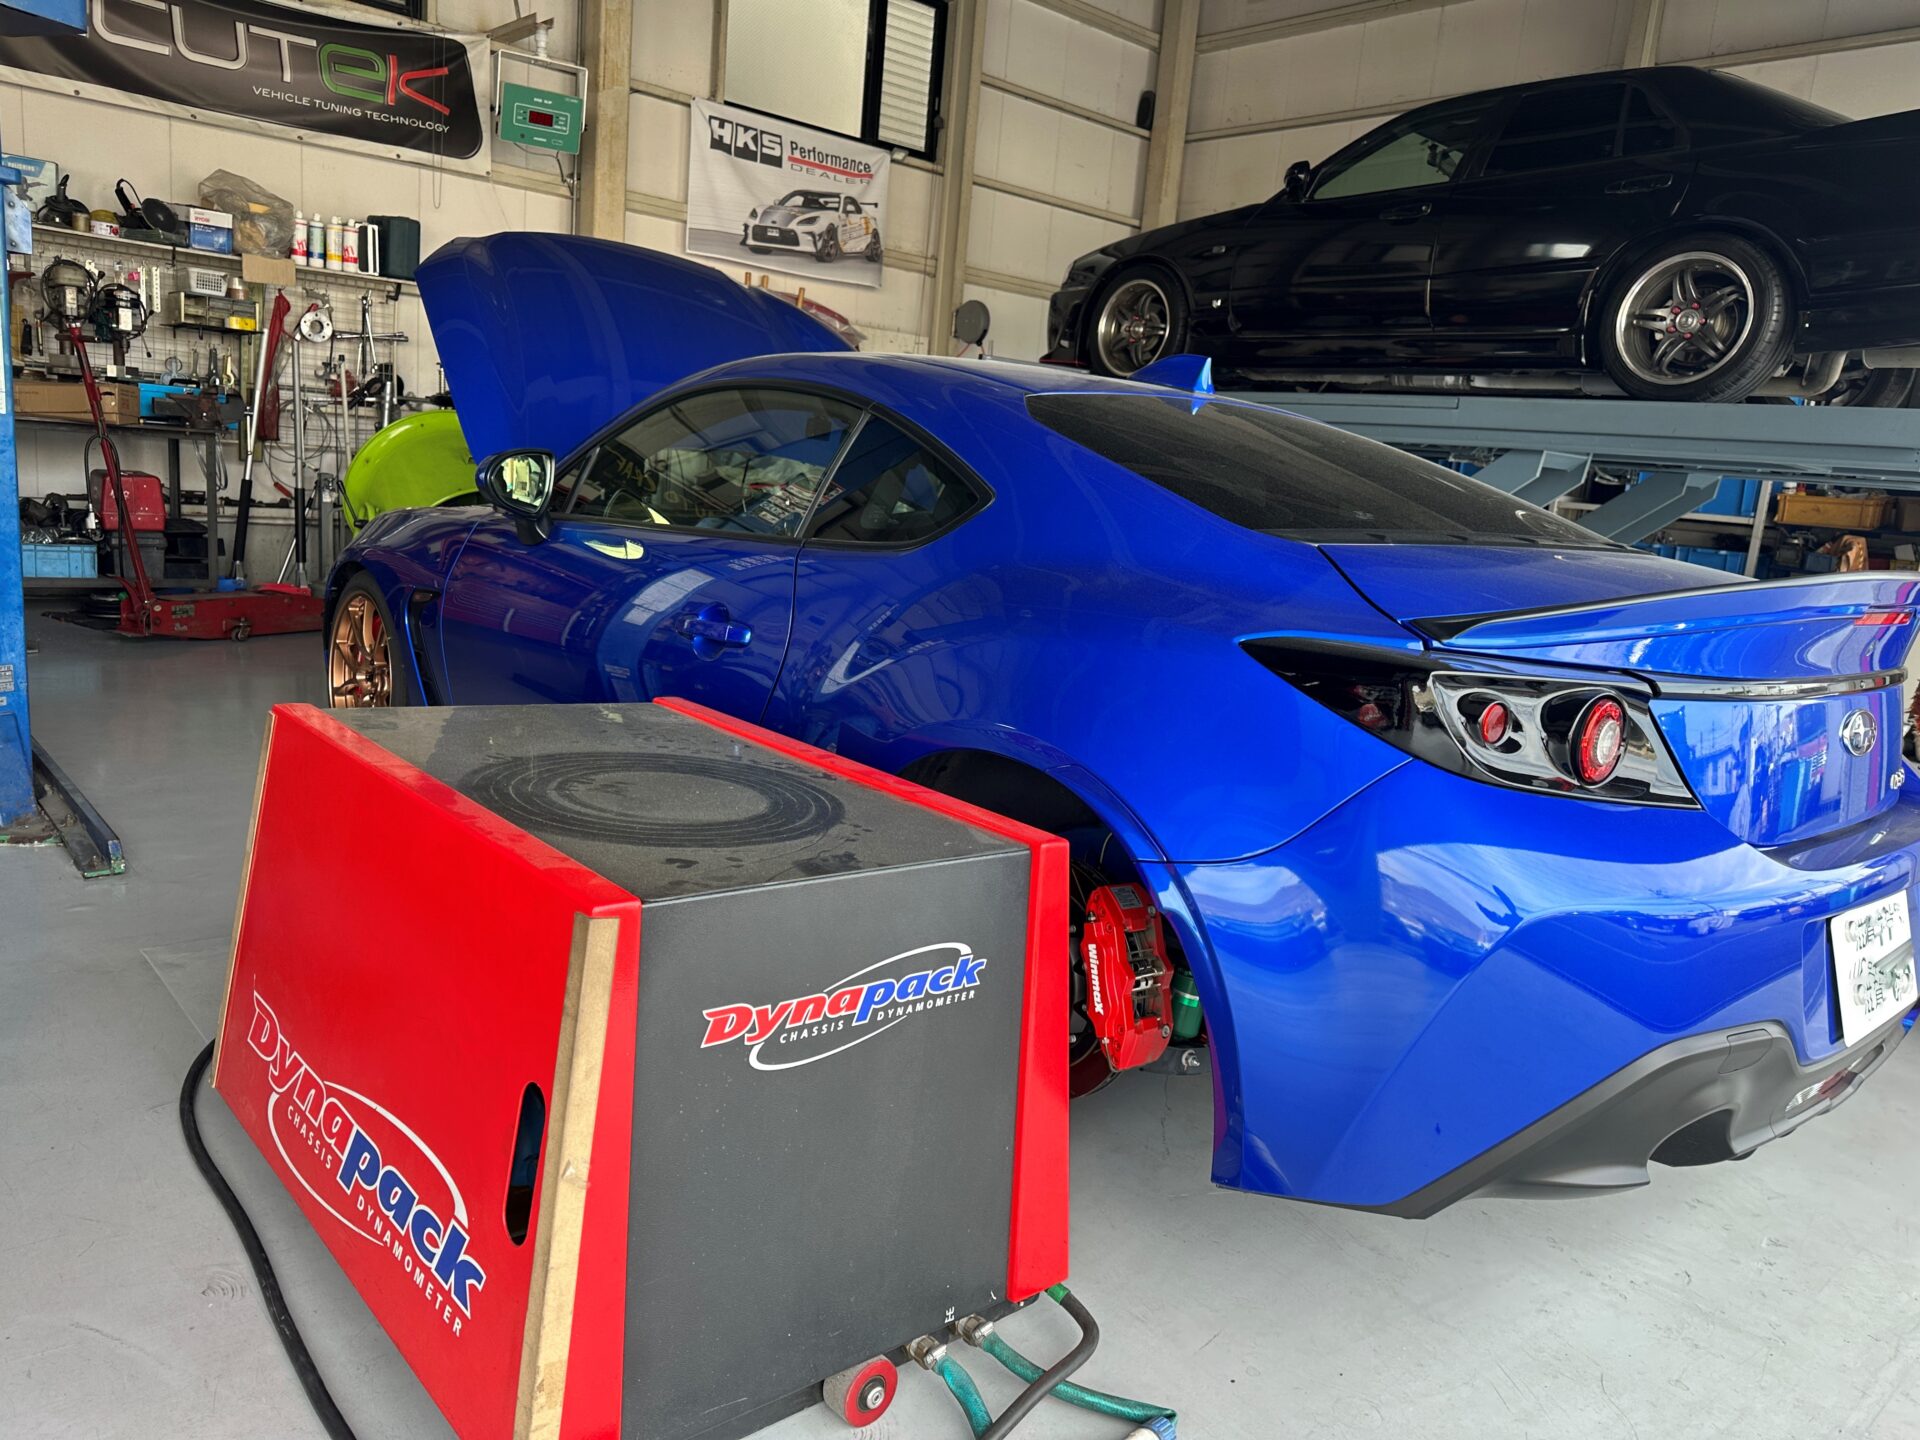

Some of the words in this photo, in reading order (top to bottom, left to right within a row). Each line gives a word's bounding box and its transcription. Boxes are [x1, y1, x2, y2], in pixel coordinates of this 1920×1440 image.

[252, 86, 311, 106] VEHICLE
[313, 99, 362, 117] TUNING
[364, 110, 450, 134] TECHNOLOGY
[709, 116, 783, 164] HKS
[790, 140, 873, 174] Performance
[790, 163, 872, 185] DEALER
[700, 954, 987, 1049] Dynapack
[779, 1019, 845, 1044] CHASSIS
[877, 990, 976, 1021] DYNAMOMETER
[247, 989, 486, 1319] Dynapack
[287, 1105, 333, 1169] CHASSIS
[356, 1196, 463, 1337] DYNAMOMETER
